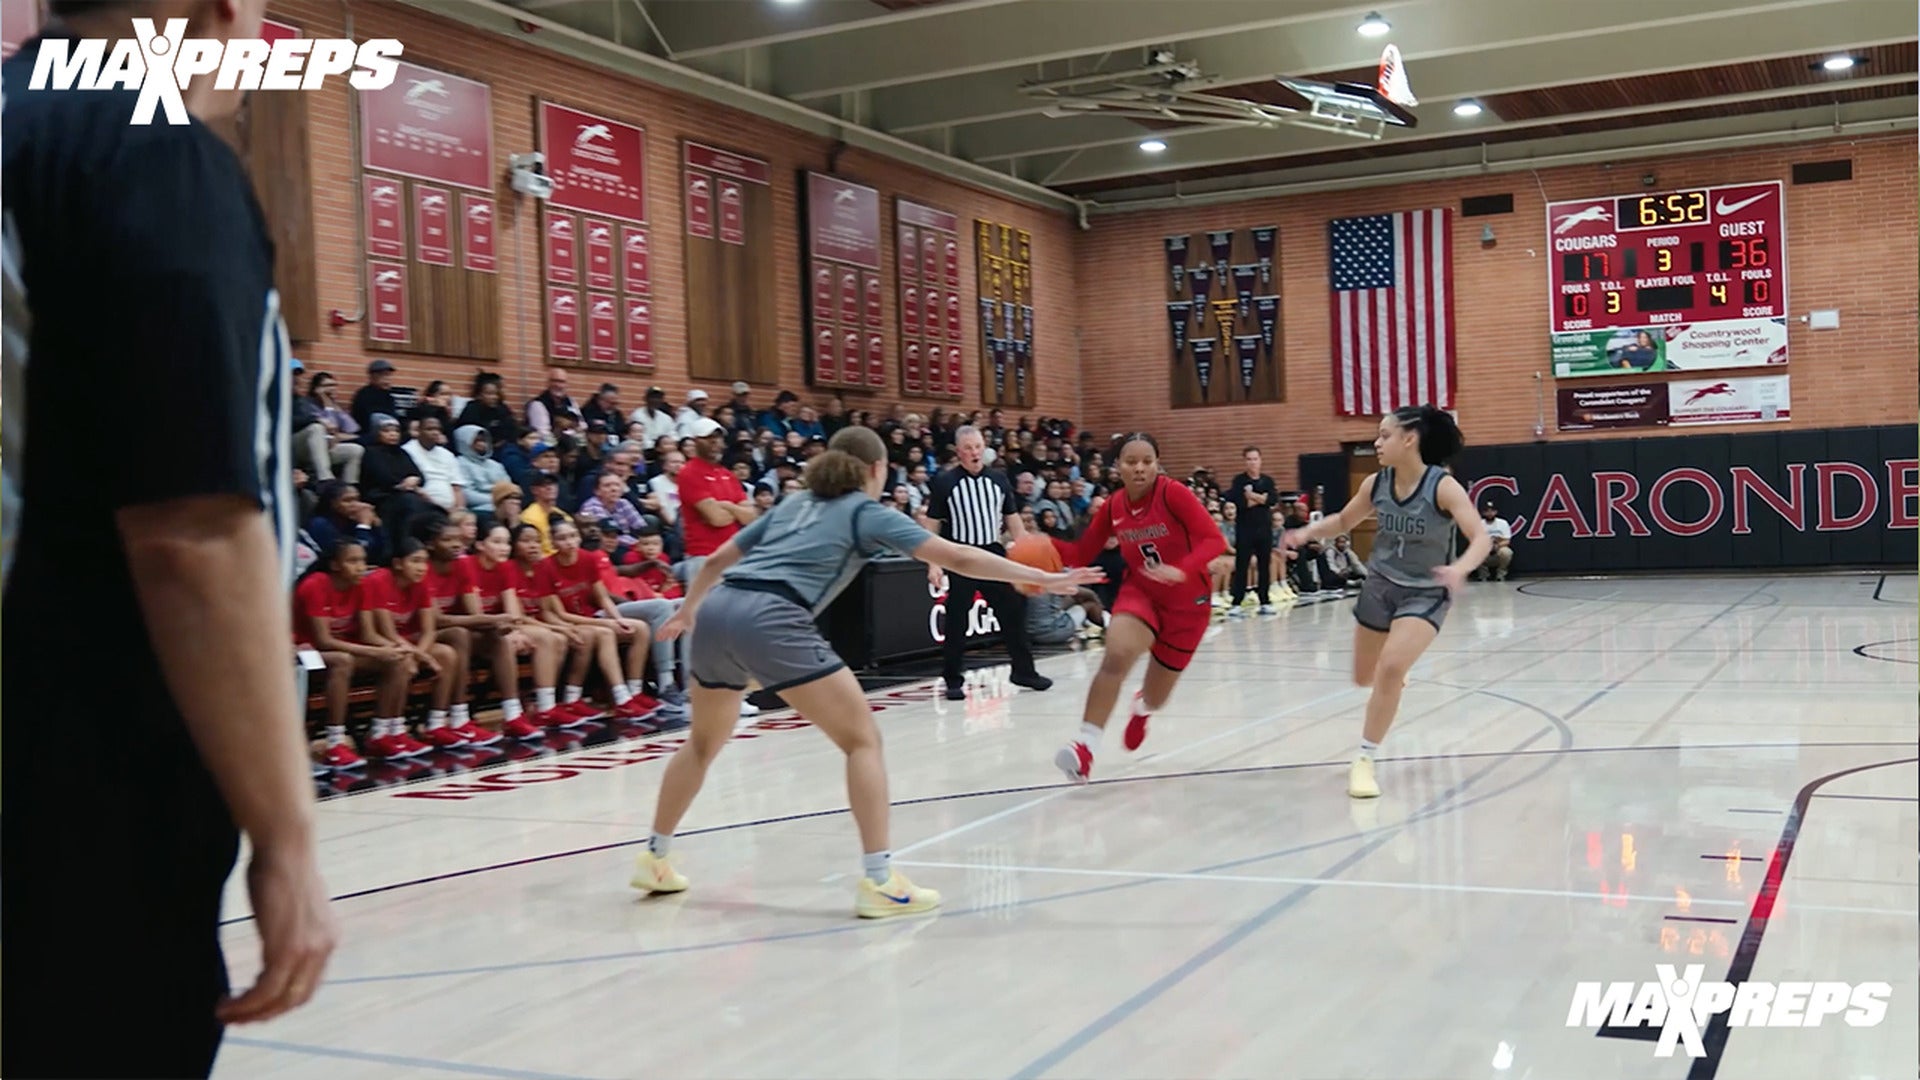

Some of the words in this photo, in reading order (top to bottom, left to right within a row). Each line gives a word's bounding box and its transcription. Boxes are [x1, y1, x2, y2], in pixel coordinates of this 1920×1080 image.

[1640, 193, 1704, 225] 6:52
[1719, 220, 1765, 237] GUEST
[1555, 234, 1617, 251] COUGARS
[1646, 236, 1680, 247] PERIOD
[1658, 249, 1671, 271] 3
[1731, 239, 1767, 268] 36
[1583, 252, 1609, 278] 17
[1635, 277, 1671, 288] PLAYER
[1672, 275, 1696, 286] FOUL
[1741, 269, 1772, 280] FOULS
[1561, 283, 1591, 294] FOULS
[1711, 284, 1727, 304] 4
[1753, 280, 1768, 302] 0
[1573, 294, 1587, 316] 0
[1607, 291, 1620, 313] 3
[1649, 312, 1682, 323] MATCH
[1742, 306, 1774, 317] SCORE
[1563, 319, 1592, 330] SCORE
[1689, 326, 1761, 339] Countrywood
[1682, 340, 1731, 350] Shopping
[1734, 337, 1770, 346] Center
